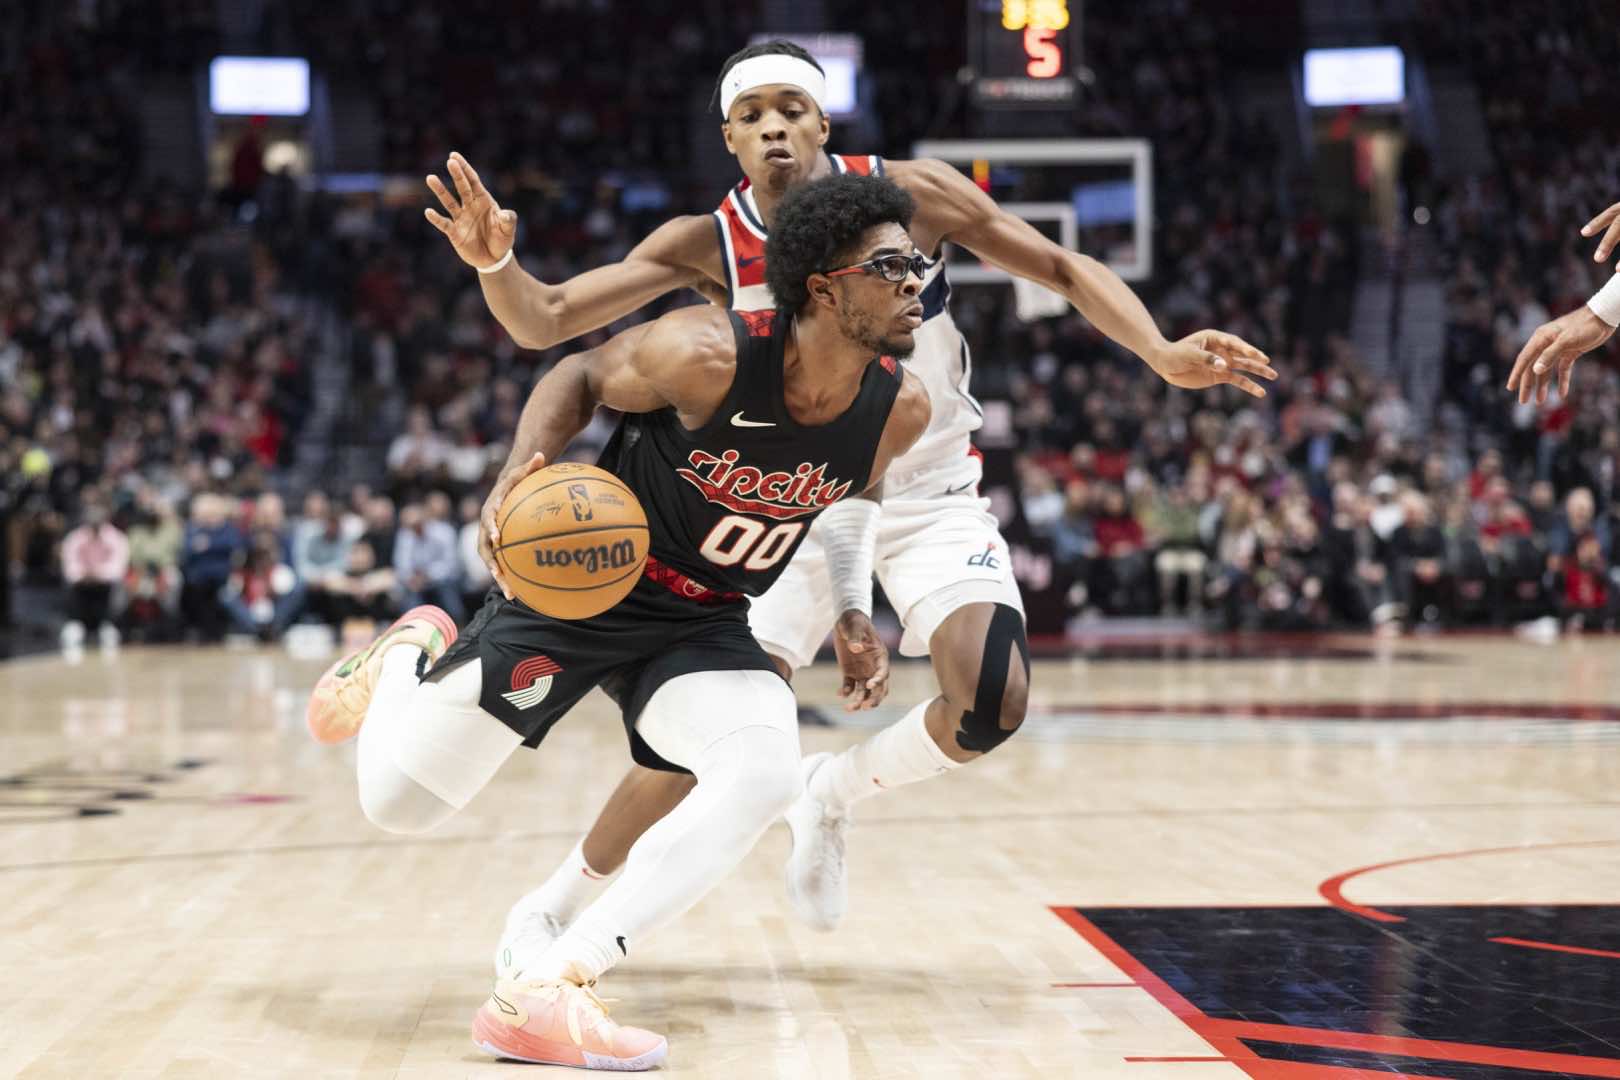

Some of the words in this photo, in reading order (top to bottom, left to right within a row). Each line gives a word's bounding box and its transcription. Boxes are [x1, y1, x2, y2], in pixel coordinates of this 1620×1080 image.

[1023, 26, 1061, 78] 5
[535, 538, 636, 574] Wilson
[699, 514, 804, 571] 00
